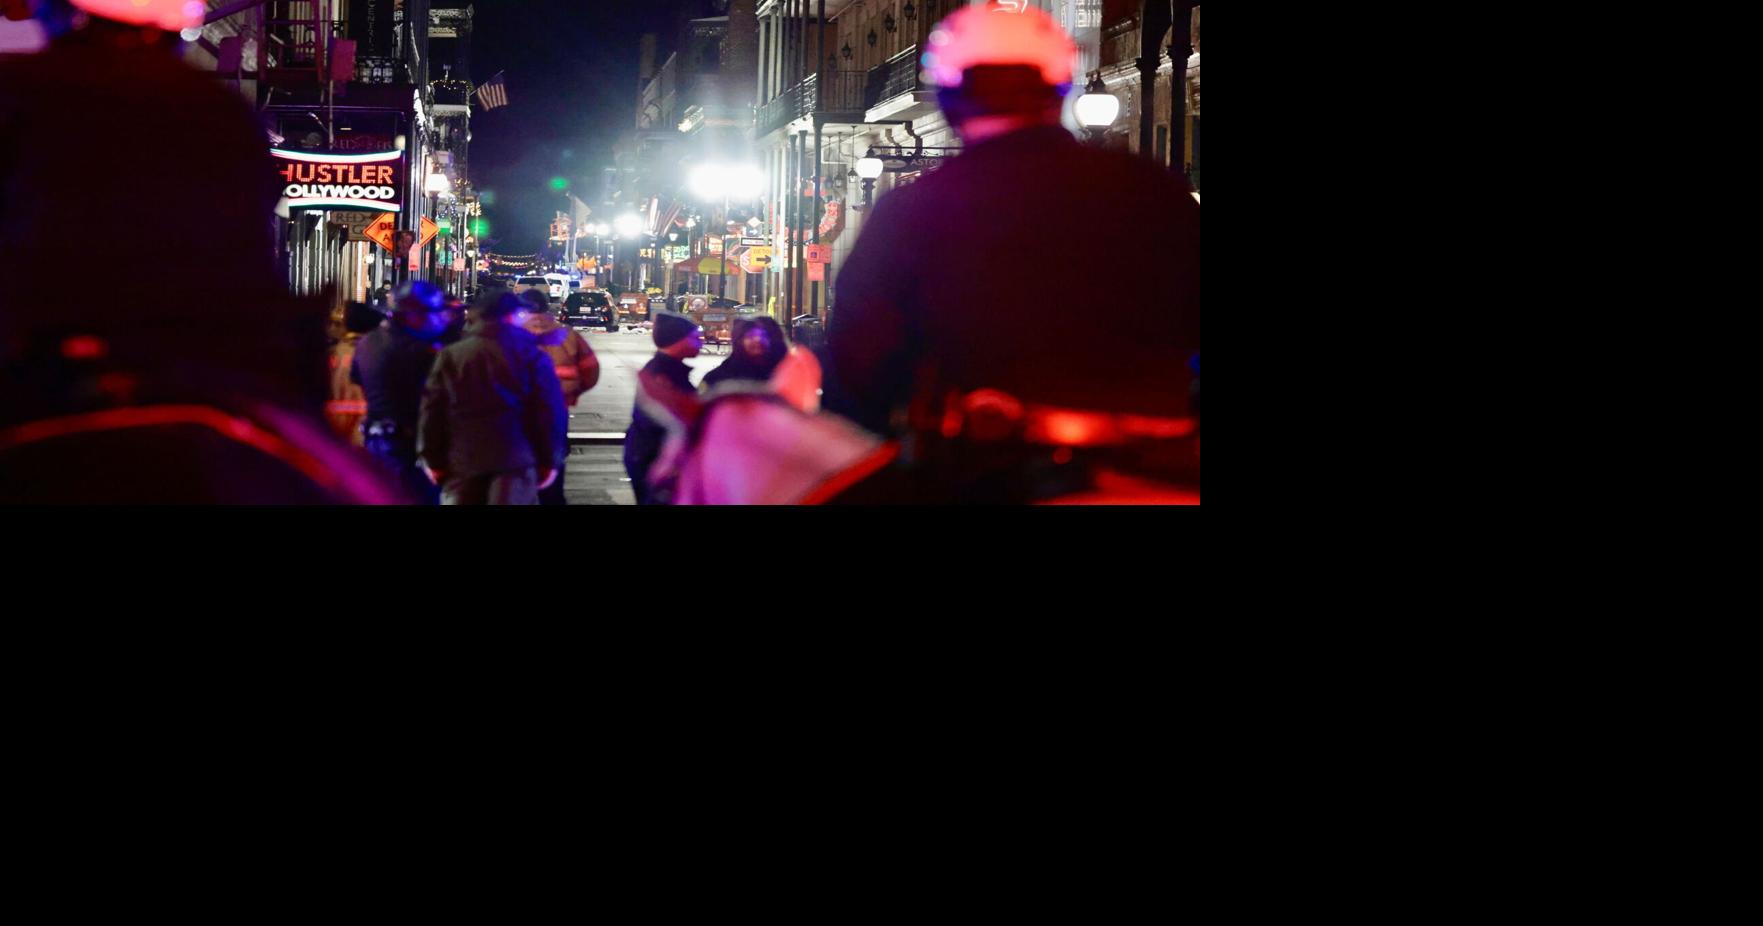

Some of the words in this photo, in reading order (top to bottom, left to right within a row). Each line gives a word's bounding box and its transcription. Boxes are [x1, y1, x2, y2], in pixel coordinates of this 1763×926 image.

[911, 158, 940, 166] ASTO
[280, 164, 394, 184] HUSTLER
[284, 184, 395, 199] OLLYWOOD
[335, 212, 365, 222] RED
